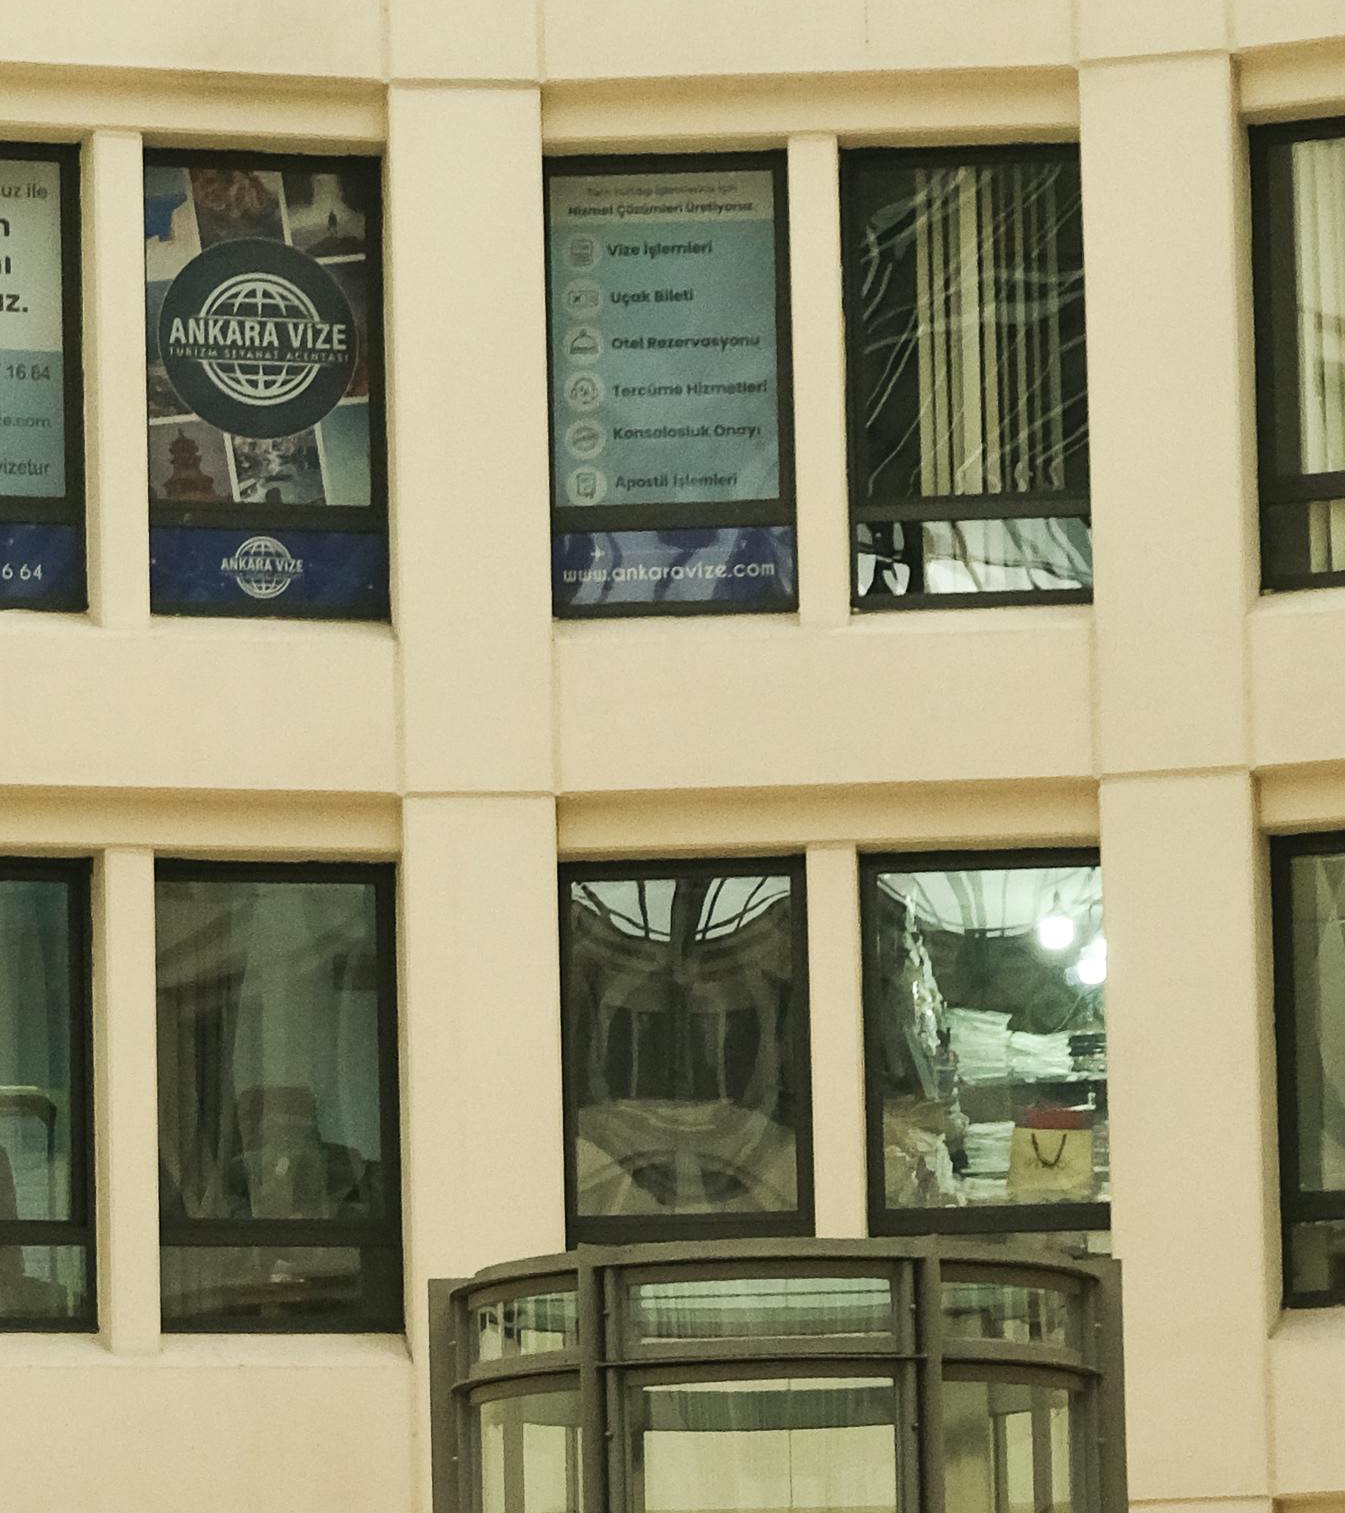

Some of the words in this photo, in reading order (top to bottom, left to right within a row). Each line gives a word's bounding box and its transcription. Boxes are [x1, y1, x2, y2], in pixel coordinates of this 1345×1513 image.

[27, 183, 49, 199] ile
[607, 243, 640, 257] Vize
[610, 290, 650, 306] Uçak
[654, 287, 694, 303] Bileti
[169, 317, 280, 348] ANKARA
[611, 336, 644, 350] Otel
[647, 336, 761, 353] Rezervasyonu
[616, 473, 668, 491] Apostil
[19, 564, 43, 581] 64
[221, 557, 273, 572] ANKARA
[563, 561, 776, 584] www.ankaravize.com
